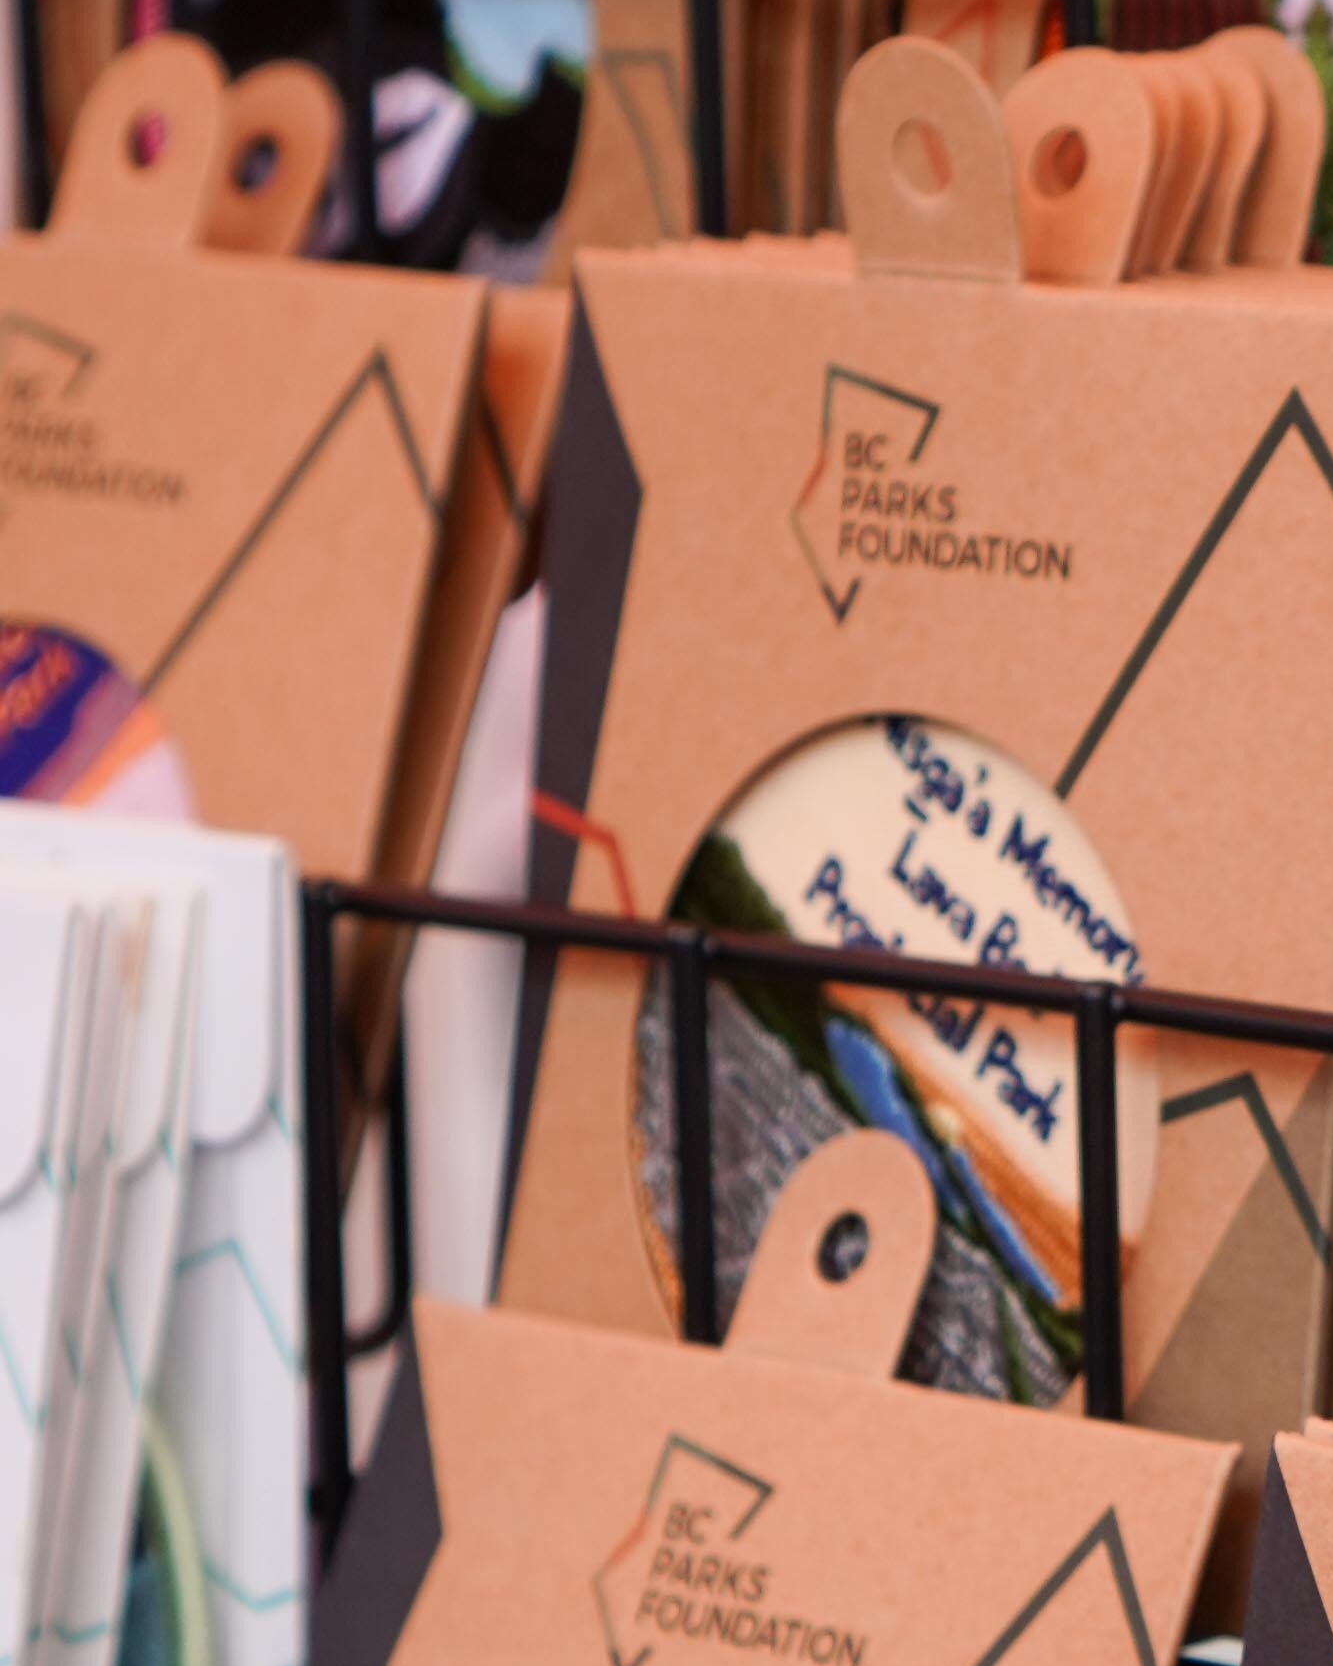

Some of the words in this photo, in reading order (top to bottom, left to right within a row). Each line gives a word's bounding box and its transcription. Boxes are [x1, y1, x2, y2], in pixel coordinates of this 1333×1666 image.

[844, 431, 888, 472] BC
[841, 476, 958, 523] PARKS
[838, 522, 1074, 581] FOUNDATION
[891, 827, 977, 943] Lava
[975, 1024, 1062, 1142] Park
[664, 1501, 714, 1544] BC
[650, 1545, 769, 1602] PARKS
